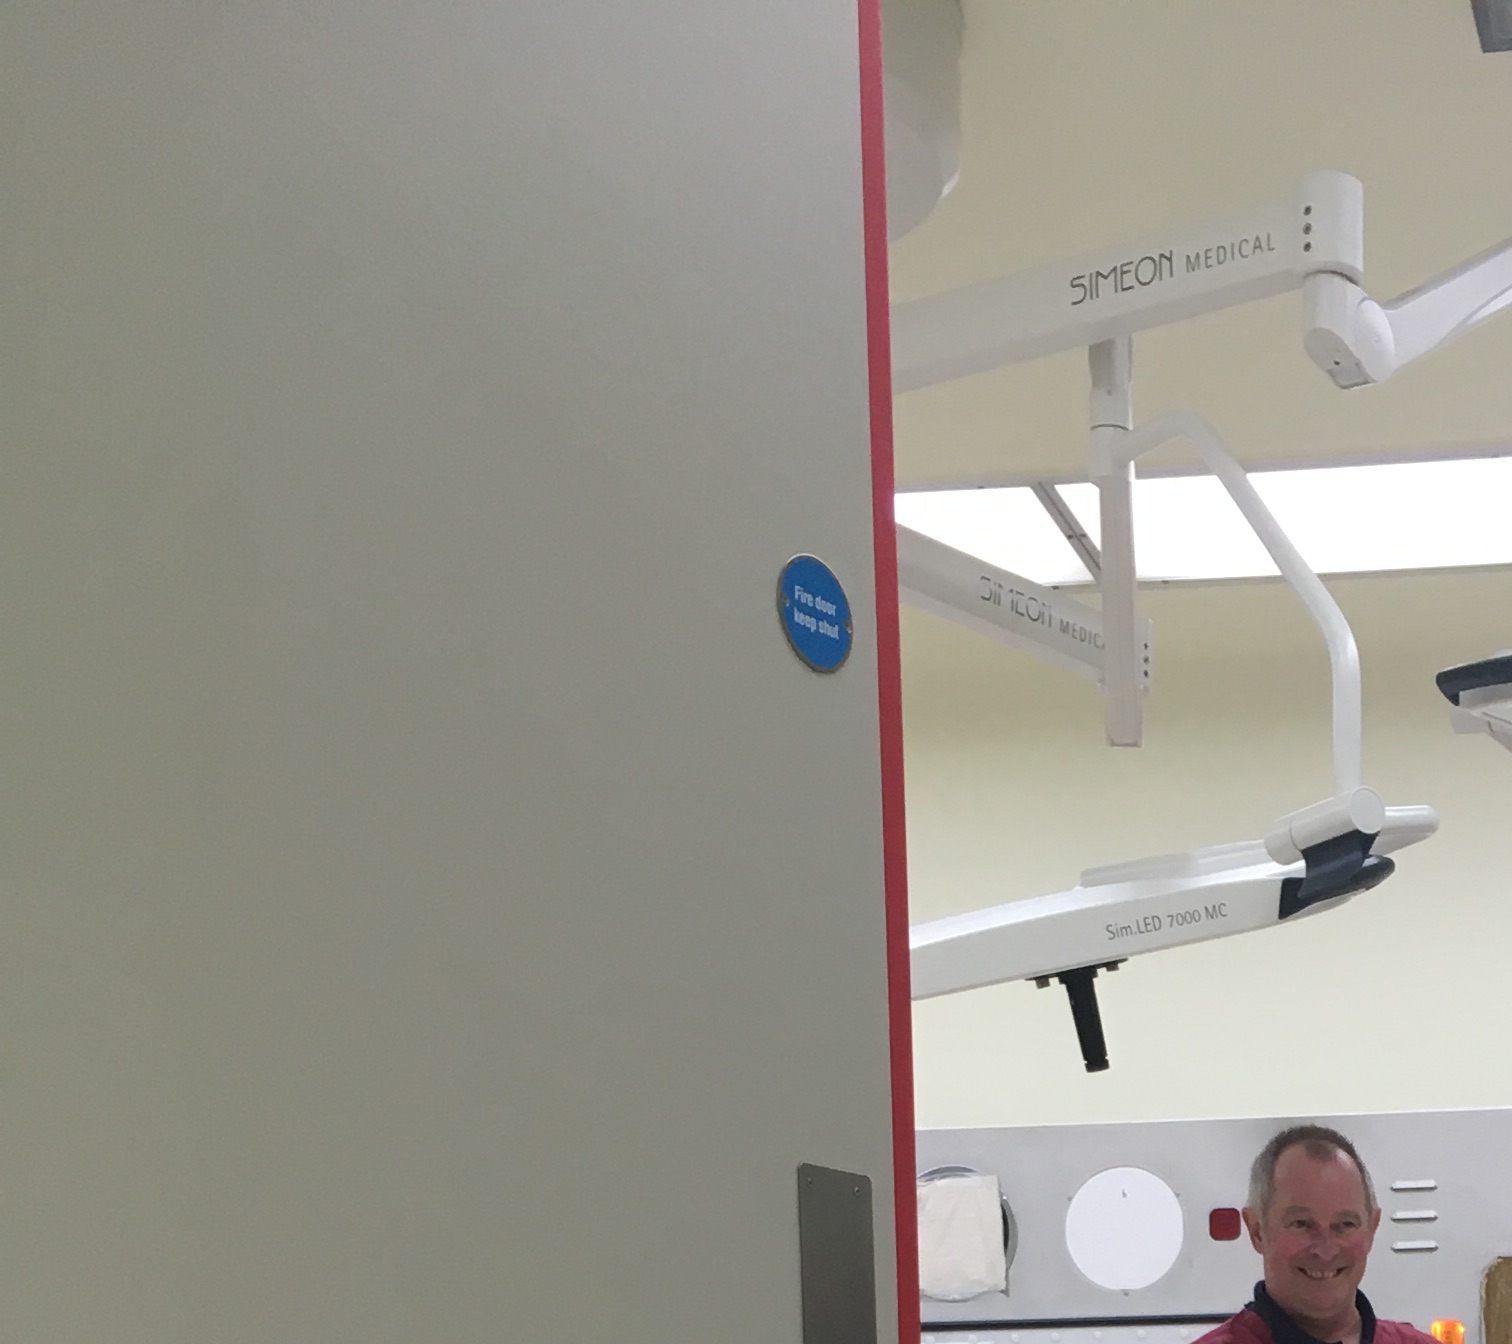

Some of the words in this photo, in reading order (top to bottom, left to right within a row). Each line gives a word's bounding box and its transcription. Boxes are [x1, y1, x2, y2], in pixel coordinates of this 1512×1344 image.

[1069, 249, 1174, 306] SIMEON
[1185, 232, 1276, 274] MEDICAL
[794, 585, 814, 607] Fire
[815, 595, 837, 617] door
[793, 606, 817, 633] keep
[818, 618, 840, 640] shut
[1059, 617, 1104, 650] MEDIC
[1105, 914, 1162, 941] Sim.LED
[1166, 908, 1202, 928] 7000
[1204, 902, 1229, 920] MC
